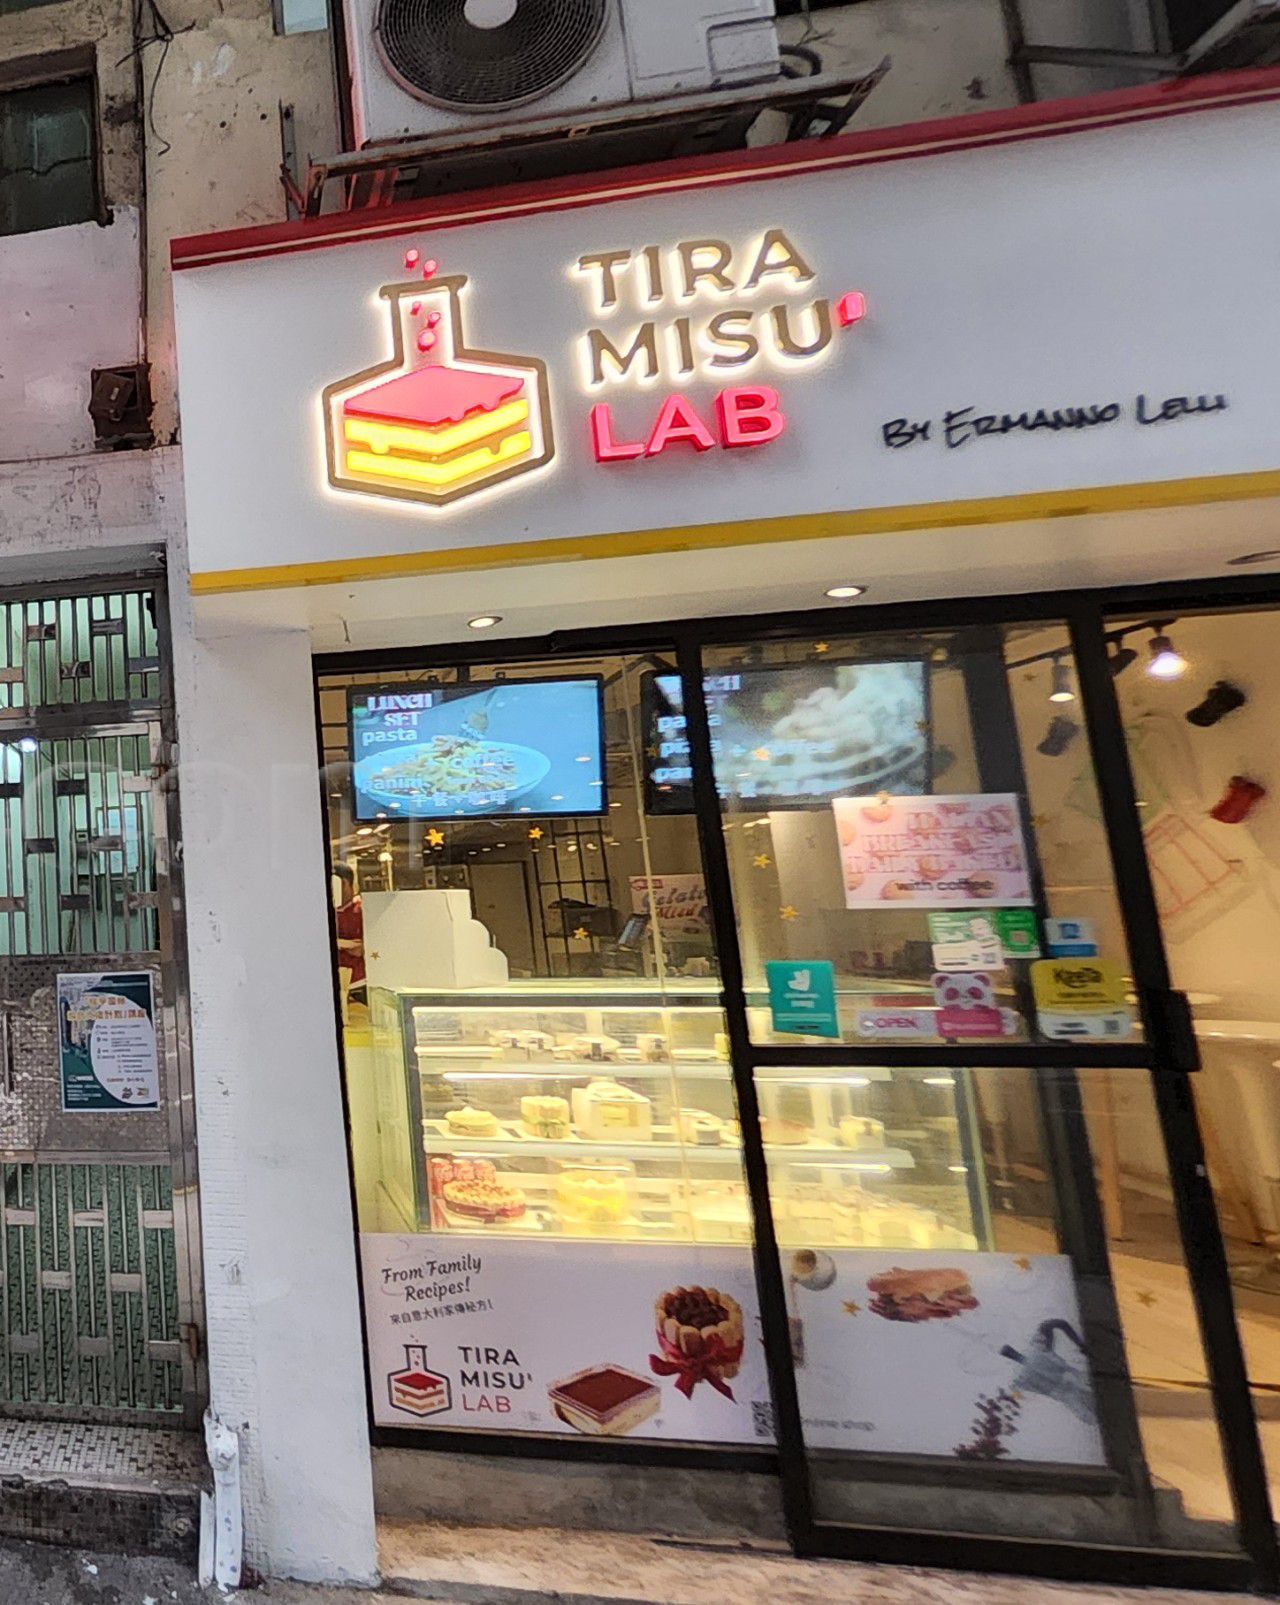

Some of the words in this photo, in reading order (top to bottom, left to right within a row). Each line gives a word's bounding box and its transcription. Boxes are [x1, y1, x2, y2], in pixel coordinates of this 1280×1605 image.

[577, 228, 816, 308] TIRA
[589, 385, 786, 464] LAB
[366, 692, 433, 713] LUNCH
[383, 711, 420, 728] SET
[361, 727, 418, 747] pasta
[875, 1016, 919, 1030] OPEN
[381, 1267, 424, 1285] From
[426, 1253, 482, 1276] Family
[404, 1275, 472, 1303] Recipes!
[457, 1345, 521, 1366] TIRA
[462, 1393, 512, 1413] LAB
